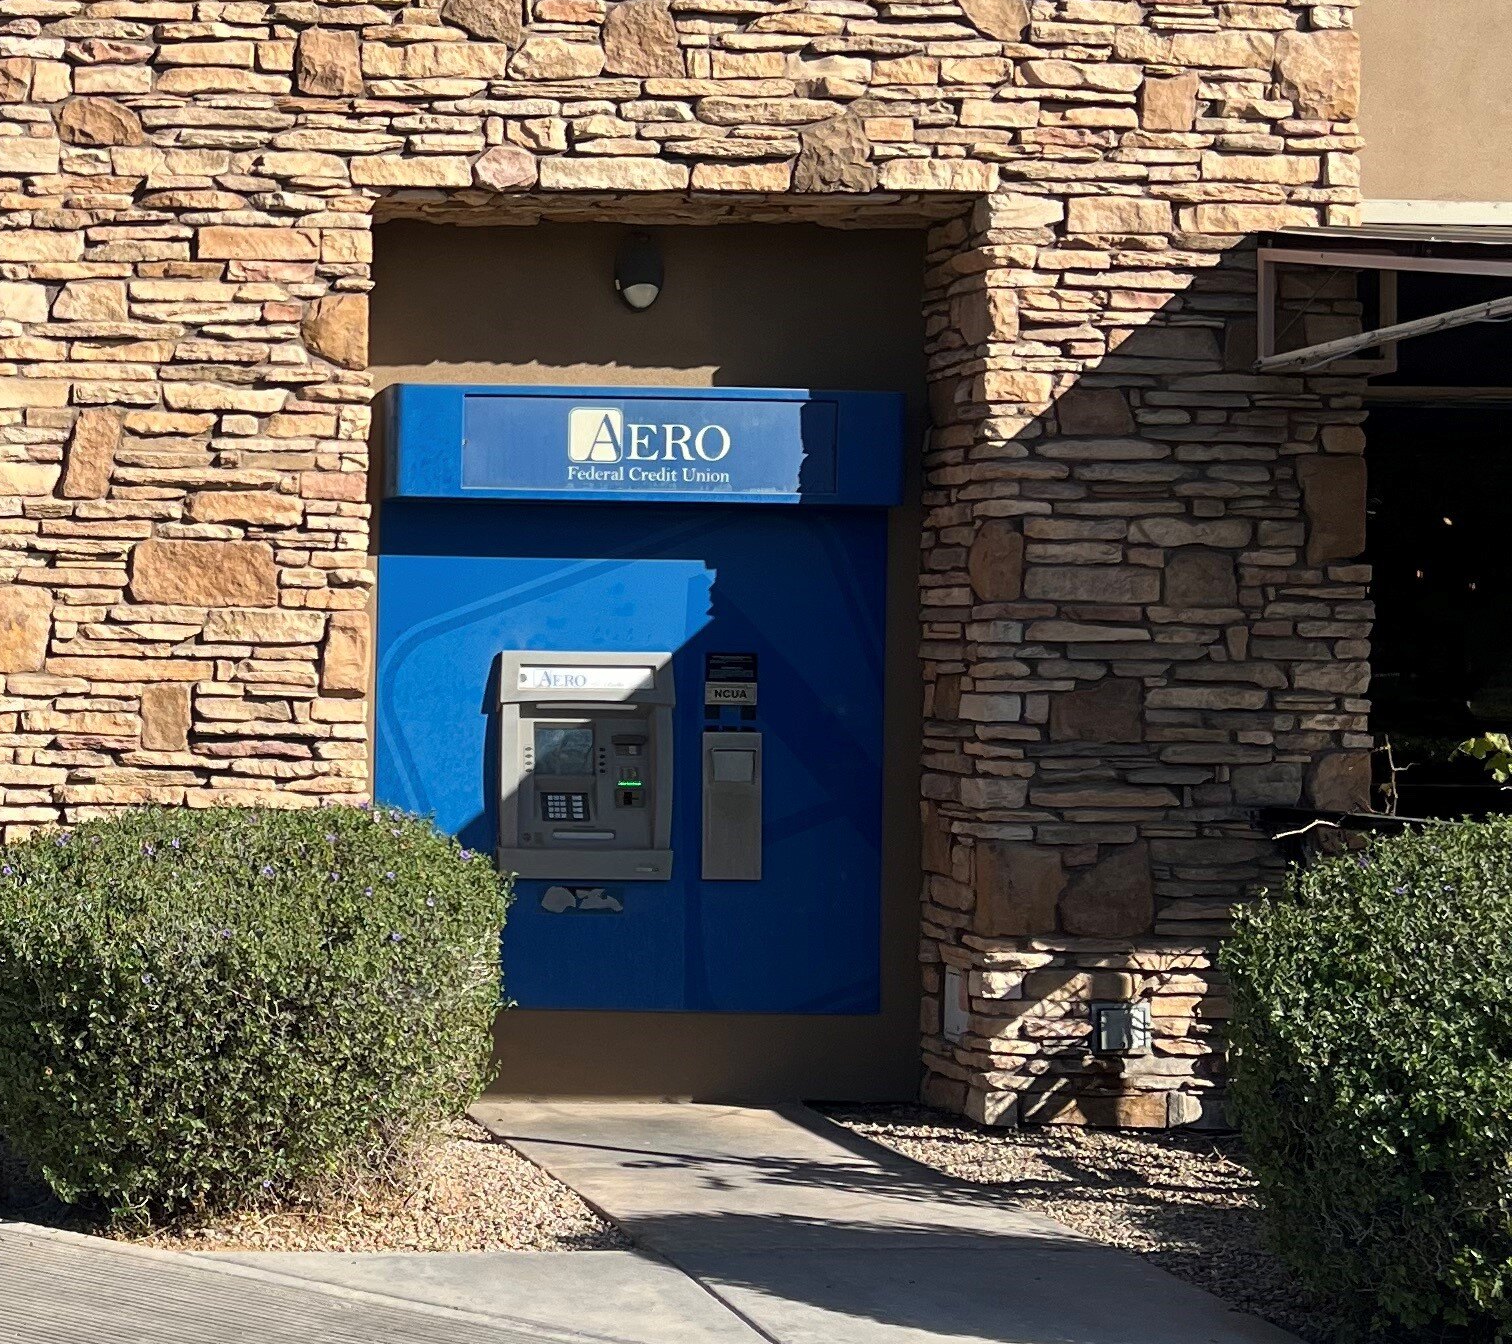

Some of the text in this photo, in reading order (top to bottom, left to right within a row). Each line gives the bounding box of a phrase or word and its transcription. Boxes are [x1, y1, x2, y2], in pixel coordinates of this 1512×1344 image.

[584, 413, 732, 462] AERO
[567, 465, 730, 483] Federal Credit Union
[537, 670, 587, 688] AERO
[714, 689, 748, 699] NCUA
